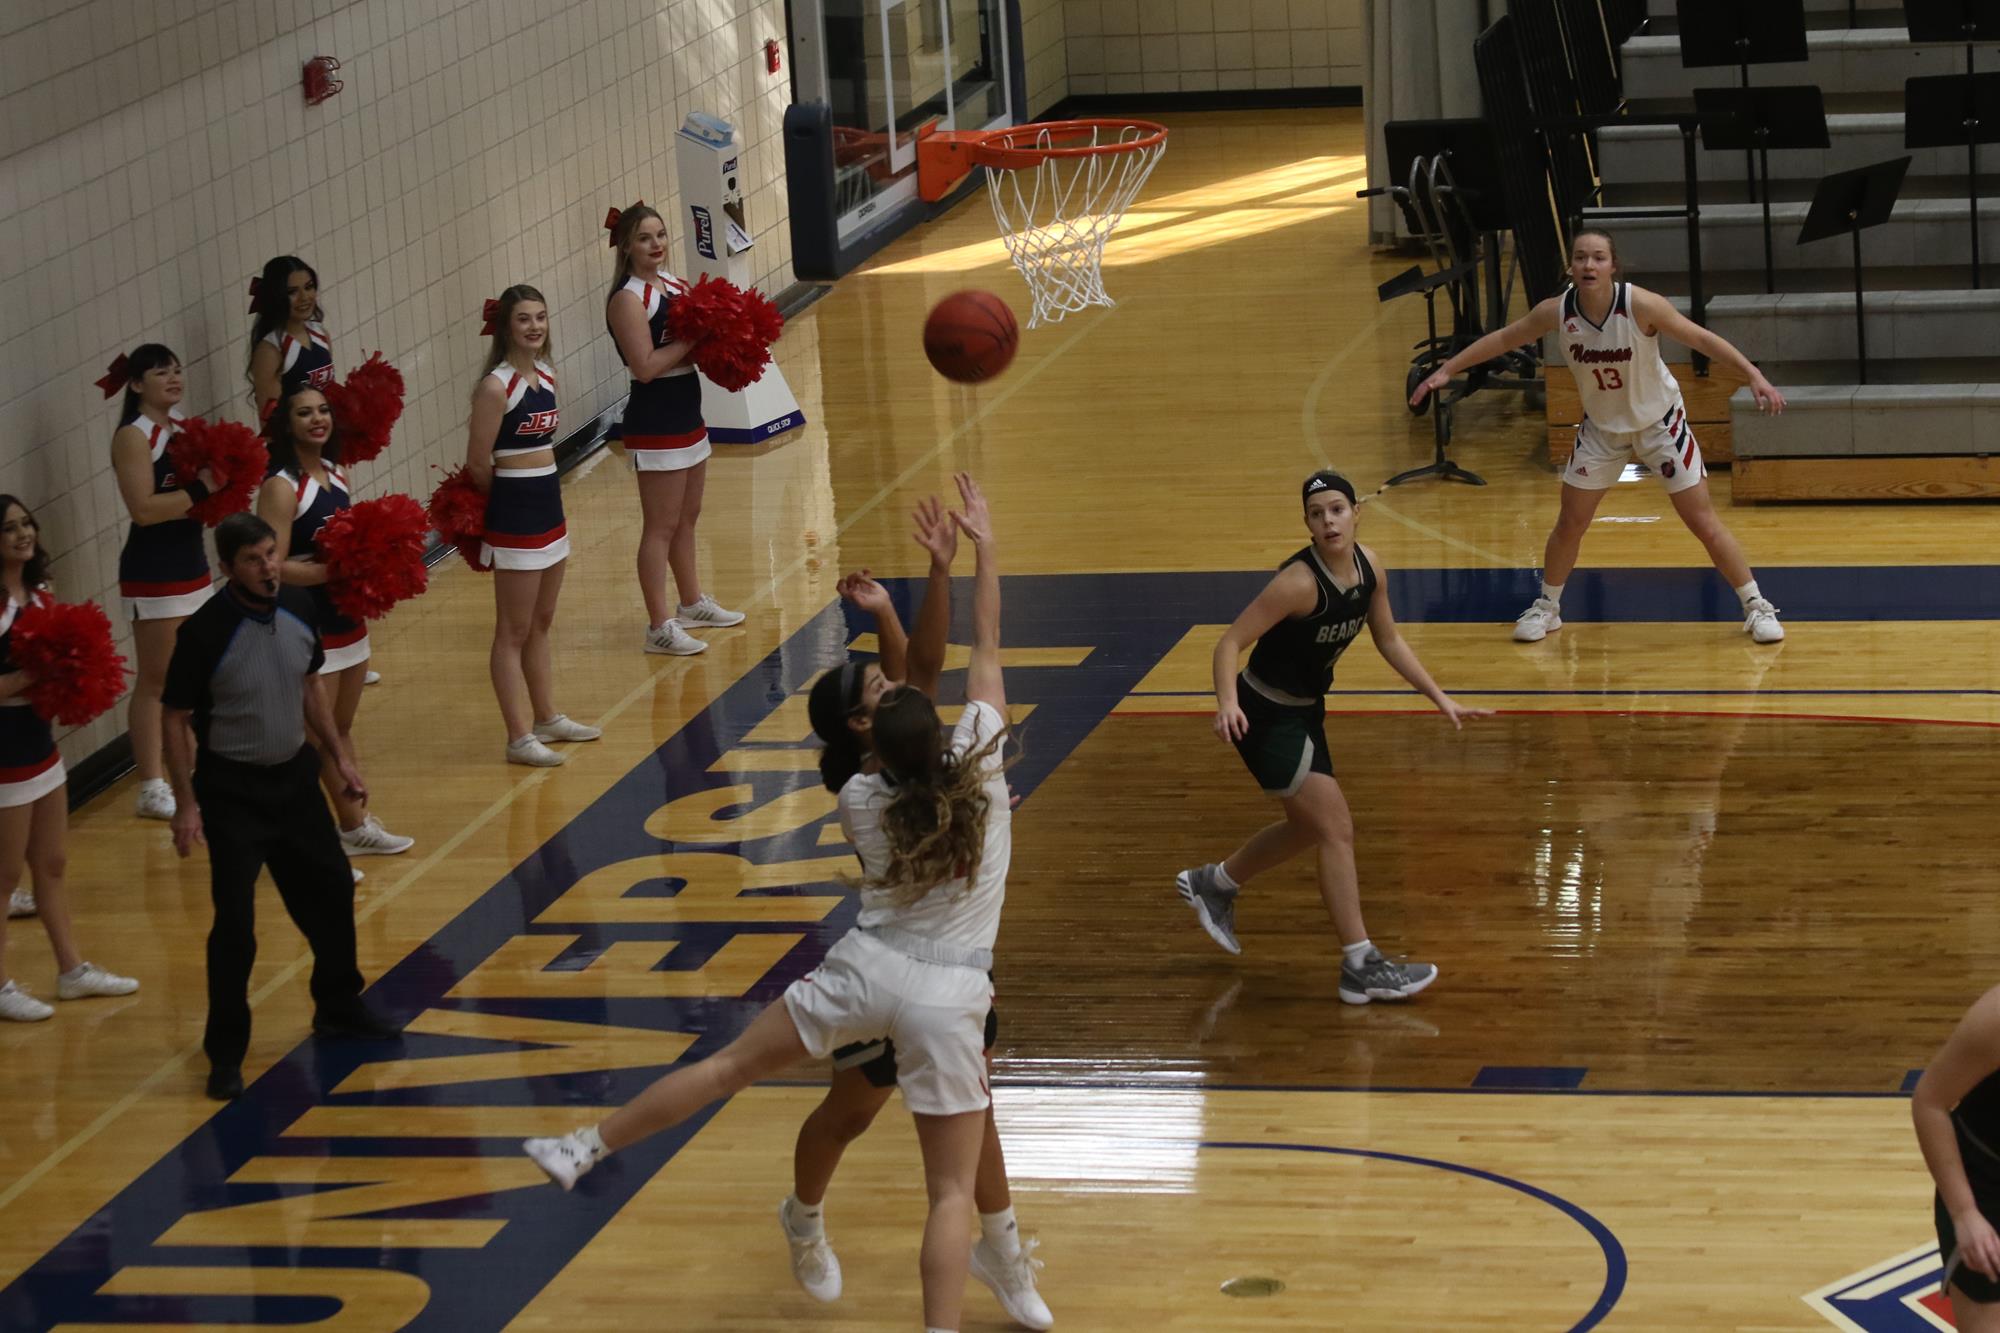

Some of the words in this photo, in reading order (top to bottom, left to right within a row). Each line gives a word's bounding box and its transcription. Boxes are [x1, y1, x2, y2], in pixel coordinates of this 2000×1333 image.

[695, 211, 712, 253] Purell
[1570, 344, 1632, 363] Newman
[301, 363, 335, 388] JET
[1592, 368, 1622, 390] 13
[1315, 612, 1367, 643] BEARC
